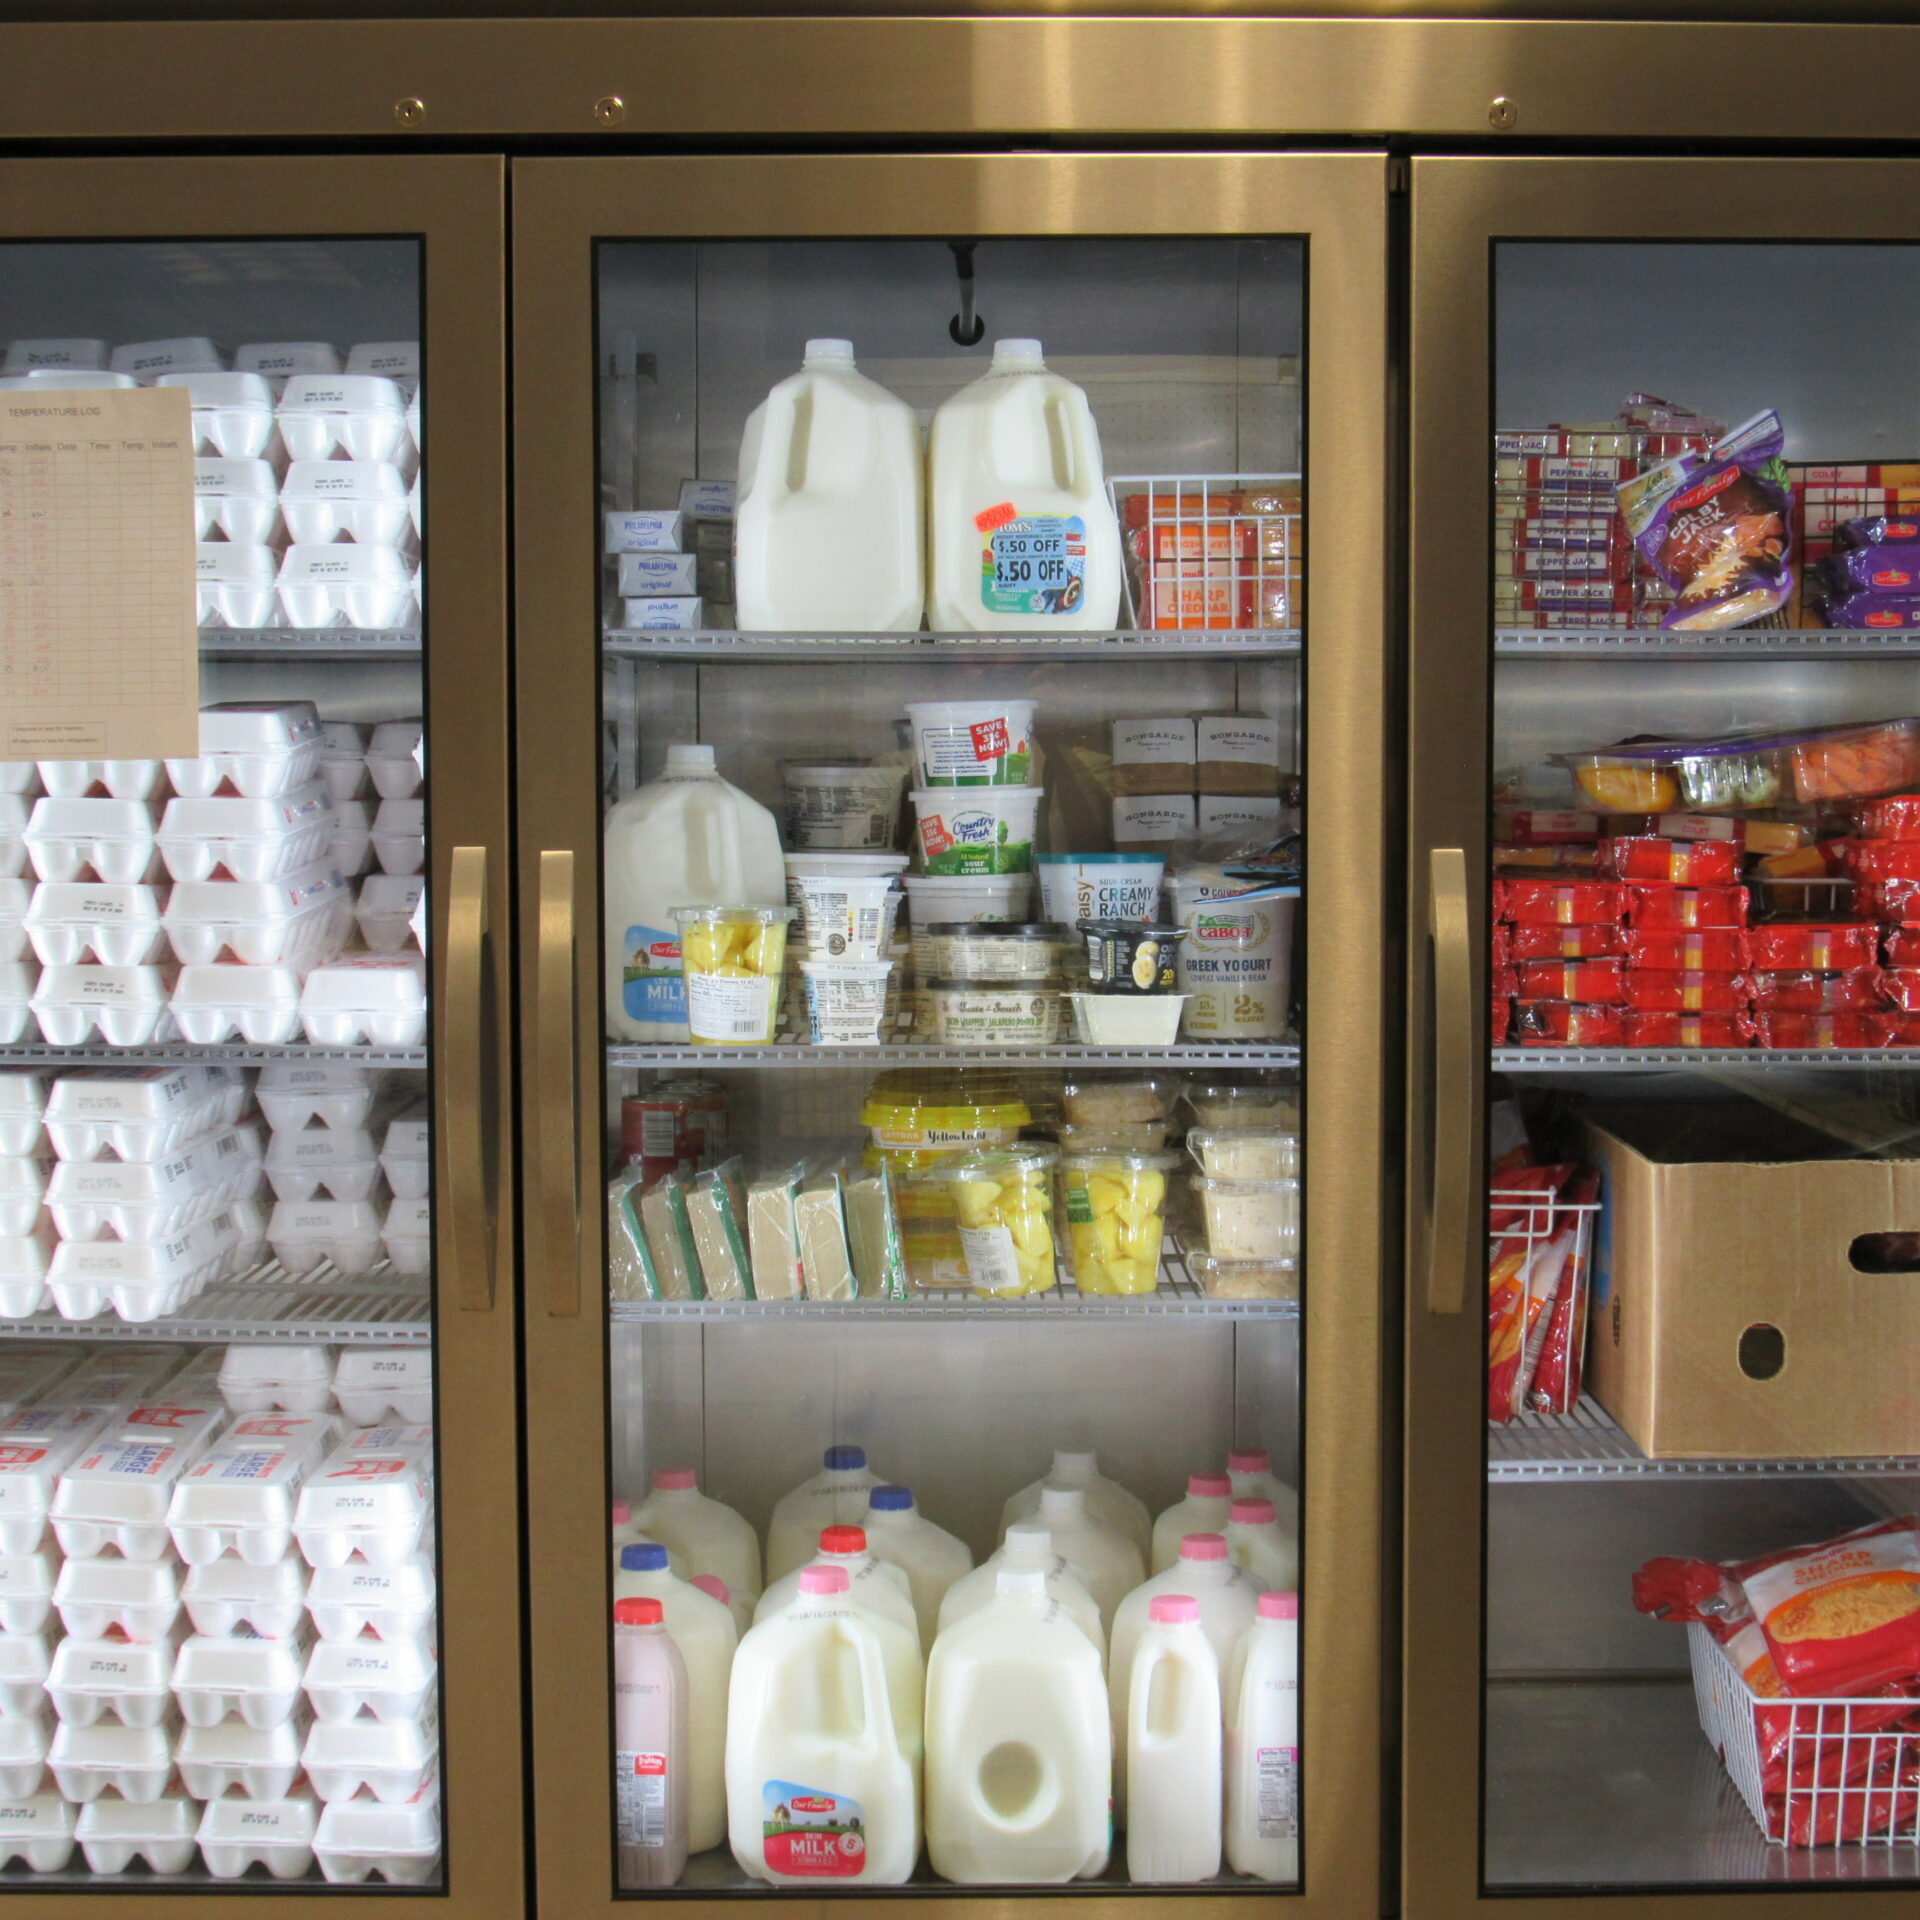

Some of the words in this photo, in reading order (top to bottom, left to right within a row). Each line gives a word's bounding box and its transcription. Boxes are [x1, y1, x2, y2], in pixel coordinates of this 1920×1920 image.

[9, 408, 78, 417] TEMPERATURE
[81, 407, 101, 416] LOG
[57, 442, 78, 450] Date
[90, 442, 111, 450] Time
[151, 440, 179, 449] Initials
[1550, 469, 1583, 477] PEPPER
[1811, 470, 1842, 479] COLBY
[1669, 495, 1722, 541] COLBY
[624, 521, 663, 530] PHILADELPHIA
[1680, 506, 1727, 545] JACK
[627, 537, 659, 547] original
[999, 540, 1027, 553] $.50
[1033, 540, 1060, 553] OFF
[638, 561, 678, 571] PHILADELPHIA
[1572, 557, 1598, 566] JACK
[996, 560, 1032, 582] $.50
[1038, 560, 1064, 581] OFF
[640, 580, 672, 590] original
[647, 602, 679, 612] original
[1167, 602, 1229, 614] CEDAR
[975, 721, 1003, 735] SAVE
[978, 738, 1007, 753] NOW!
[1209, 813, 1264, 822] BONGARD
[952, 816, 996, 836] Country
[961, 826, 990, 842] Fresh
[1099, 887, 1154, 902] CREAMY
[1200, 887, 1209, 897] 6
[1077, 880, 1095, 921] aisy
[1099, 902, 1146, 917] RANCH
[1187, 960, 1219, 972] GREEK
[1223, 958, 1272, 972] YOGURT
[1215, 975, 1246, 983] VANILLA
[1248, 973, 1267, 981] BEAN
[993, 1001, 1022, 1013] South
[928, 1129, 960, 1144] Yellow
[124, 1445, 164, 1474] LARGE
[236, 1452, 274, 1478] LARGE
[1794, 1551, 1872, 1578] SHARP
[793, 1800, 807, 1808] Our
[808, 1800, 834, 1809] Family
[790, 1840, 836, 1856] MILK
[846, 1838, 856, 1850] S
